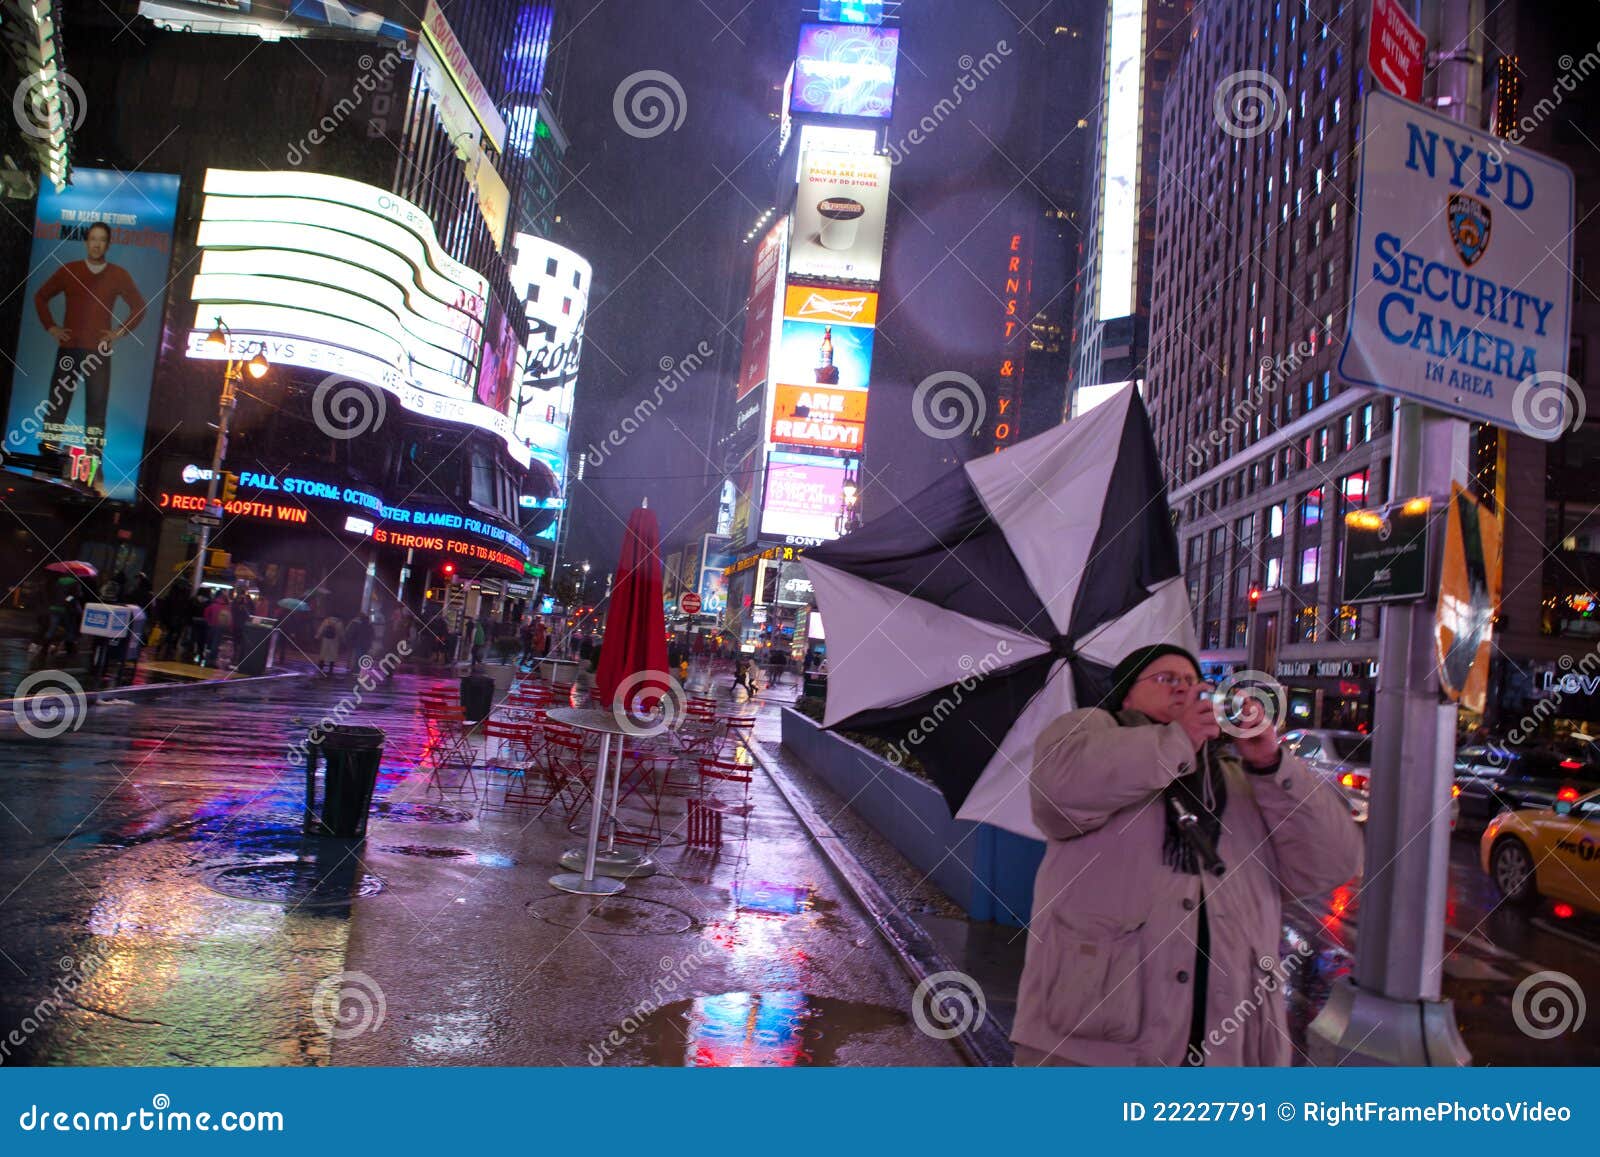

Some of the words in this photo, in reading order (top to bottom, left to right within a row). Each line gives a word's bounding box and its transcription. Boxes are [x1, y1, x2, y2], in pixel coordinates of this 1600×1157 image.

[1381, 28, 1410, 77] ANYTIME
[1388, 6, 1420, 60] STOPPING
[1405, 122, 1534, 211] NYPD
[1005, 234, 1022, 337] ERNST
[1373, 232, 1554, 336] SECURITY
[1378, 292, 1541, 387] CAMERA
[1000, 360, 1014, 377] &
[1425, 361, 1444, 384] IN
[1451, 371, 1495, 398] AREA
[797, 392, 845, 412] ARE
[224, 500, 273, 518] 409TH
[277, 506, 308, 523] WIN
[239, 471, 279, 490] FALL
[413, 511, 462, 529] BLAMED
[464, 518, 482, 535] FOR
[391, 533, 444, 550] THROWS
[447, 540, 468, 555] FOR
[469, 545, 475, 556] 5
[785, 535, 824, 547] SONY
